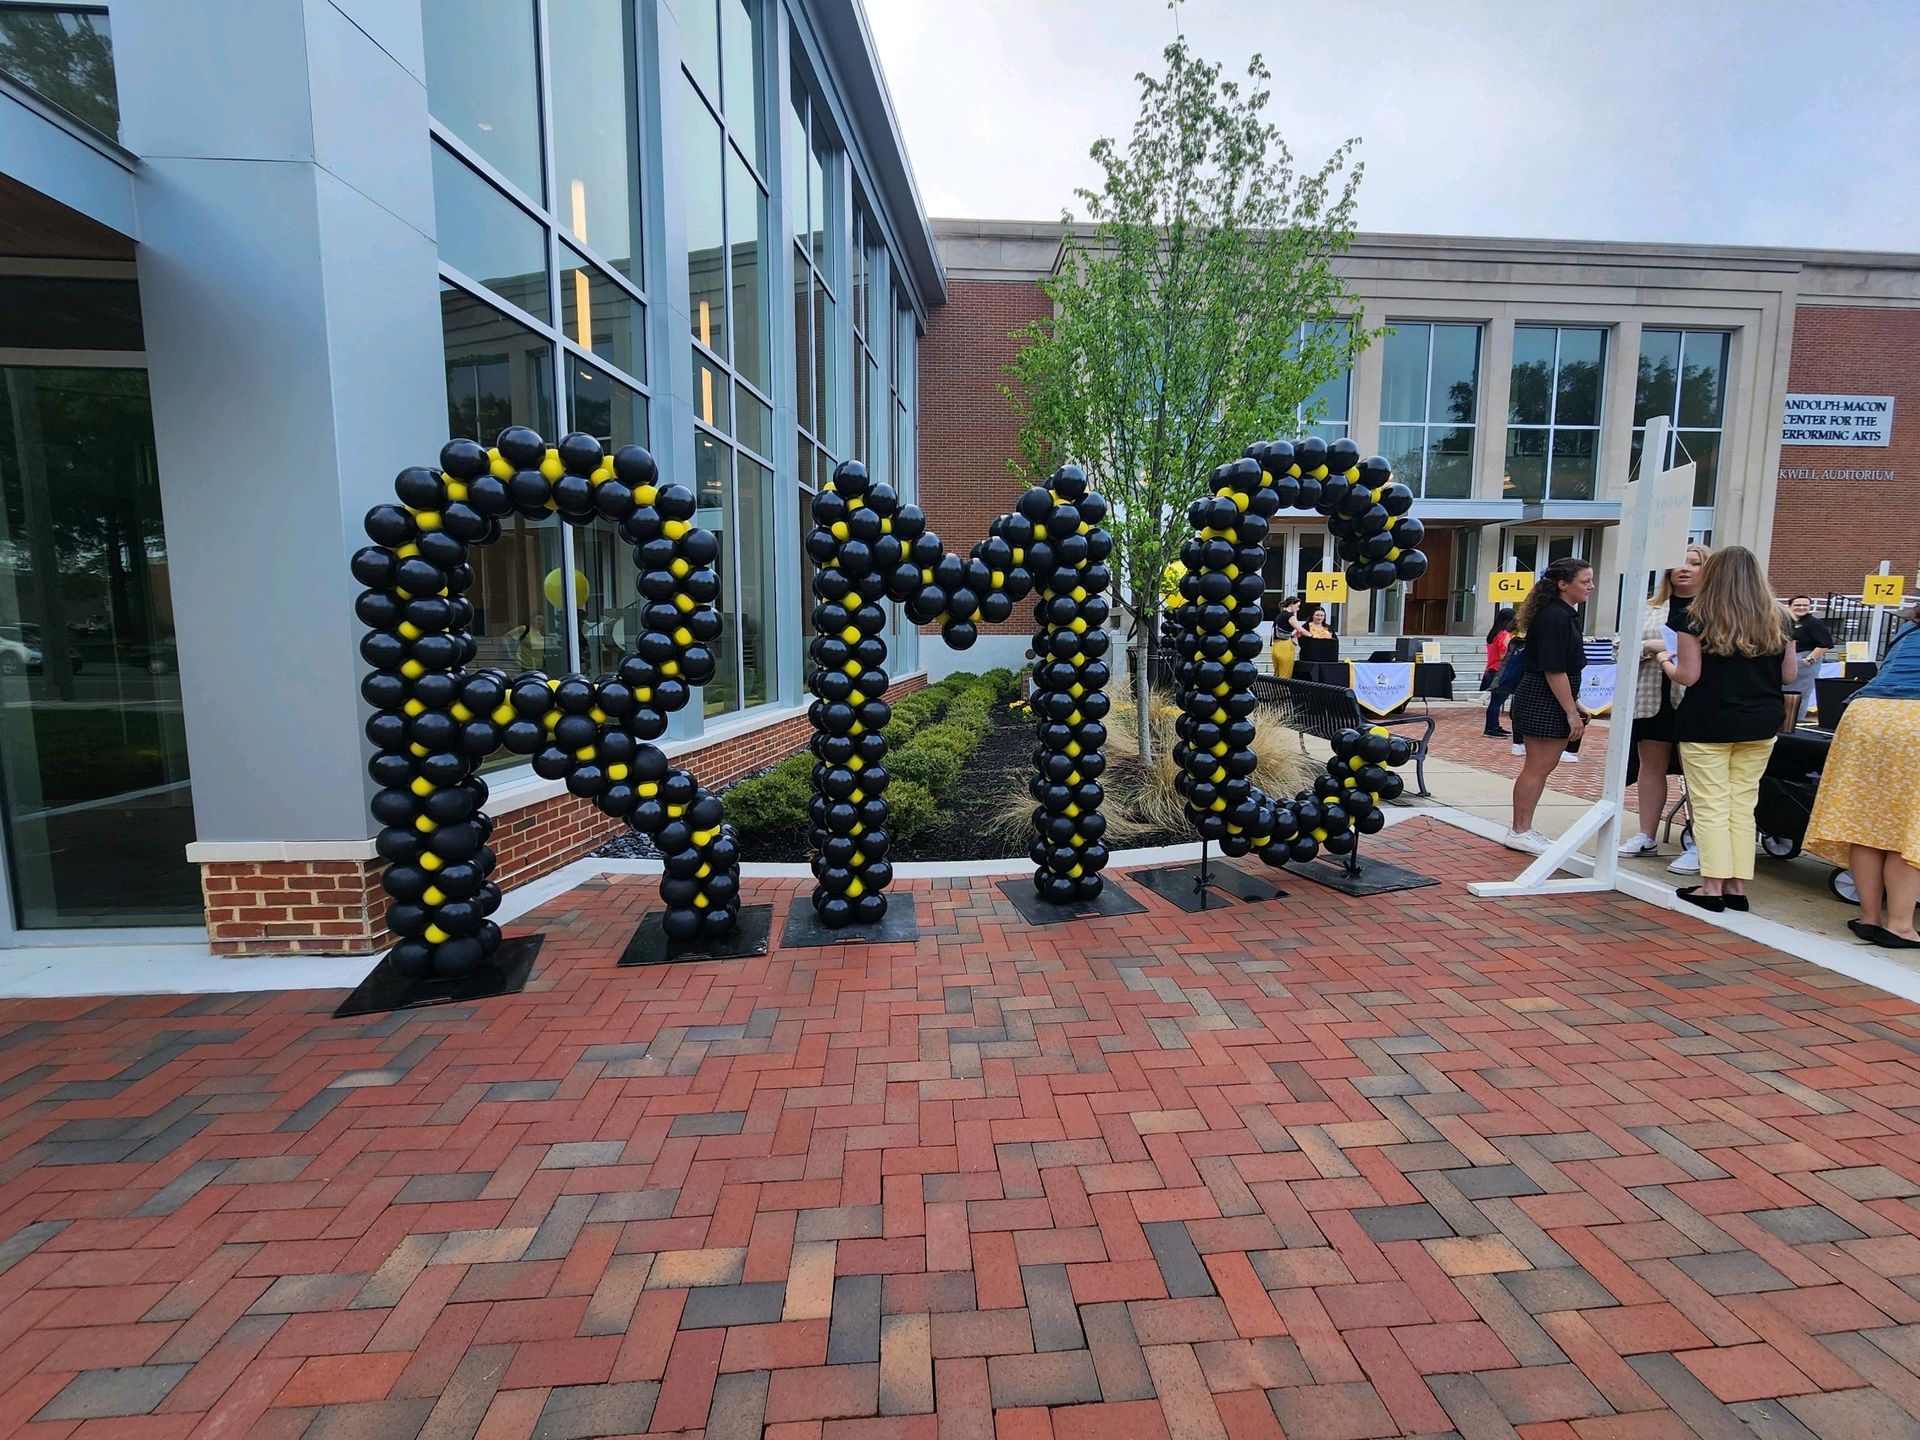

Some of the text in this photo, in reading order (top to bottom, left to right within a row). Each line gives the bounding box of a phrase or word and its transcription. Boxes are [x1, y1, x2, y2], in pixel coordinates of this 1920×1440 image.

[1785, 400, 1887, 412] ANDOLPH-MACON
[1783, 414, 1877, 426] CENTER FOR THE
[1782, 429, 1881, 441] ERFORMING ARTS
[1779, 468, 1894, 480] KWELL AUDITORIUM
[1315, 579, 1339, 591] A-F
[1498, 579, 1525, 591] G-L
[1873, 584, 1895, 595] T-Z
